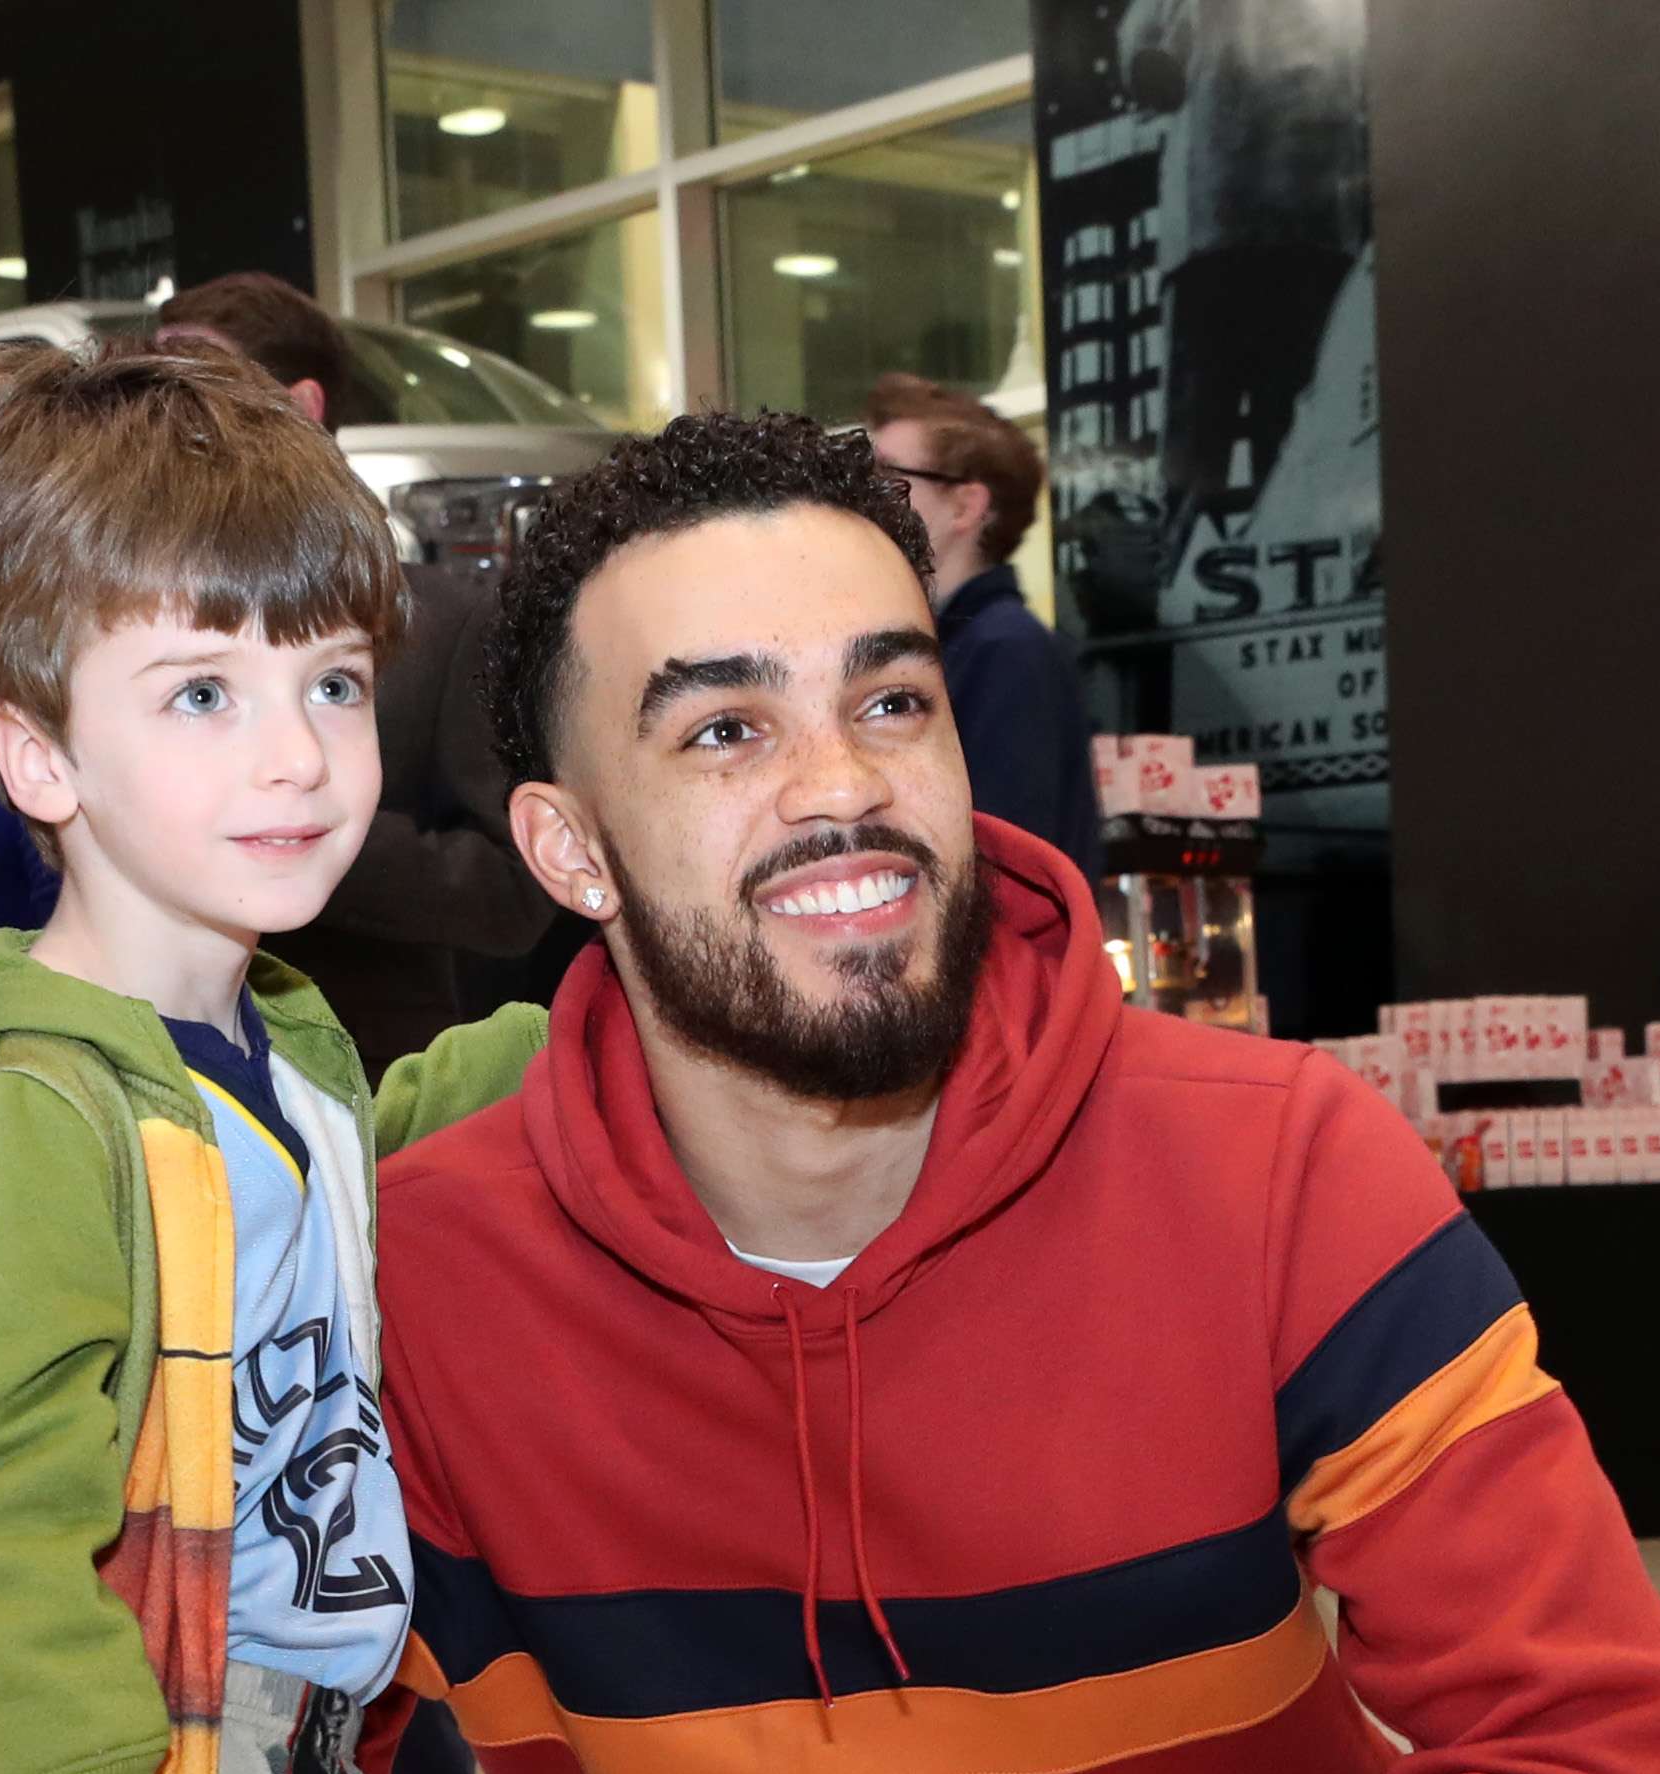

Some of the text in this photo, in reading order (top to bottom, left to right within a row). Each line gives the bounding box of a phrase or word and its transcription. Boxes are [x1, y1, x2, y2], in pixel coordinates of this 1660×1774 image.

[1238, 633, 1324, 669] STAX
[1336, 668, 1377, 699] OF
[1197, 716, 1331, 755] MERICAN
